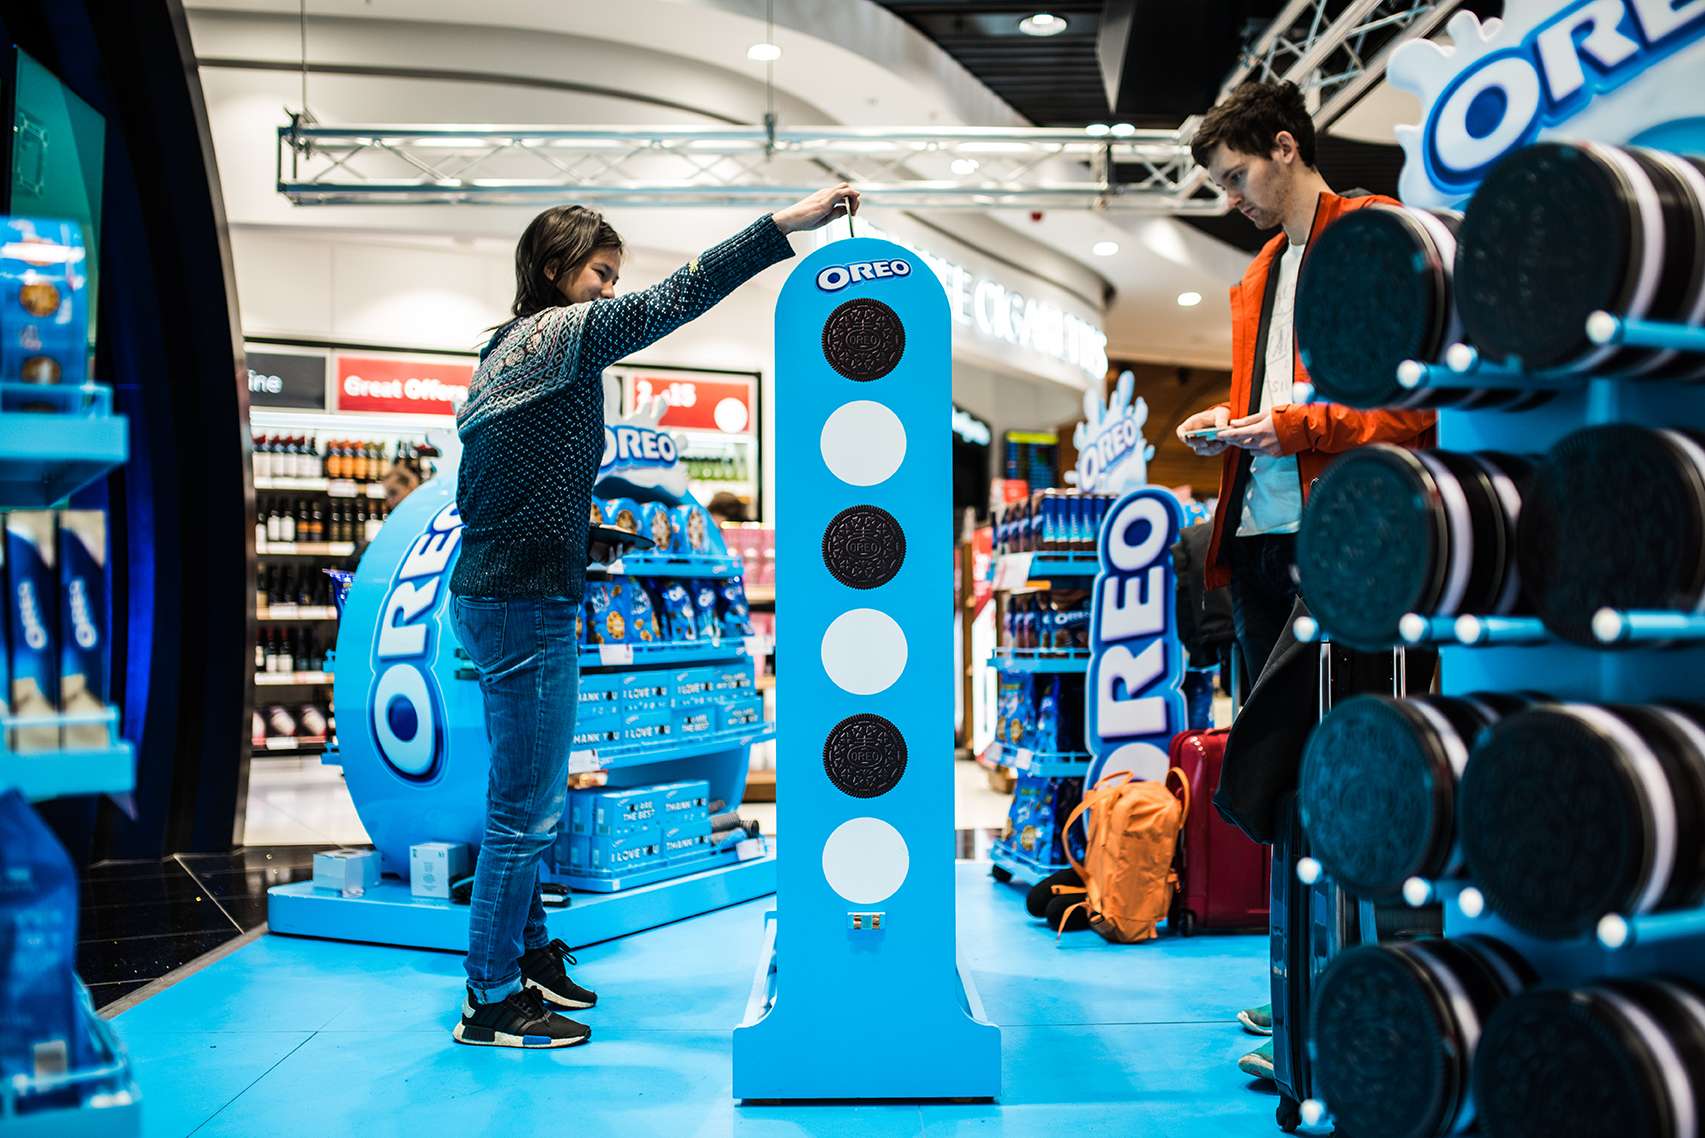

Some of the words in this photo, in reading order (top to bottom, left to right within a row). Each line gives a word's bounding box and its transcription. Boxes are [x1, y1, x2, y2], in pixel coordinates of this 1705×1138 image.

[1433, 0, 1705, 173] ORE
[817, 259, 911, 291] OREO
[849, 335, 877, 345] OREO
[247, 369, 283, 394] ine
[343, 375, 403, 399] Great
[1080, 419, 1137, 491] OREO
[849, 542, 878, 552] OREO
[628, 687, 649, 699] LOVE
[630, 726, 652, 738] LOVE
[573, 733, 600, 744] HANK
[851, 751, 879, 761] OREO
[617, 848, 640, 861] LOVE
